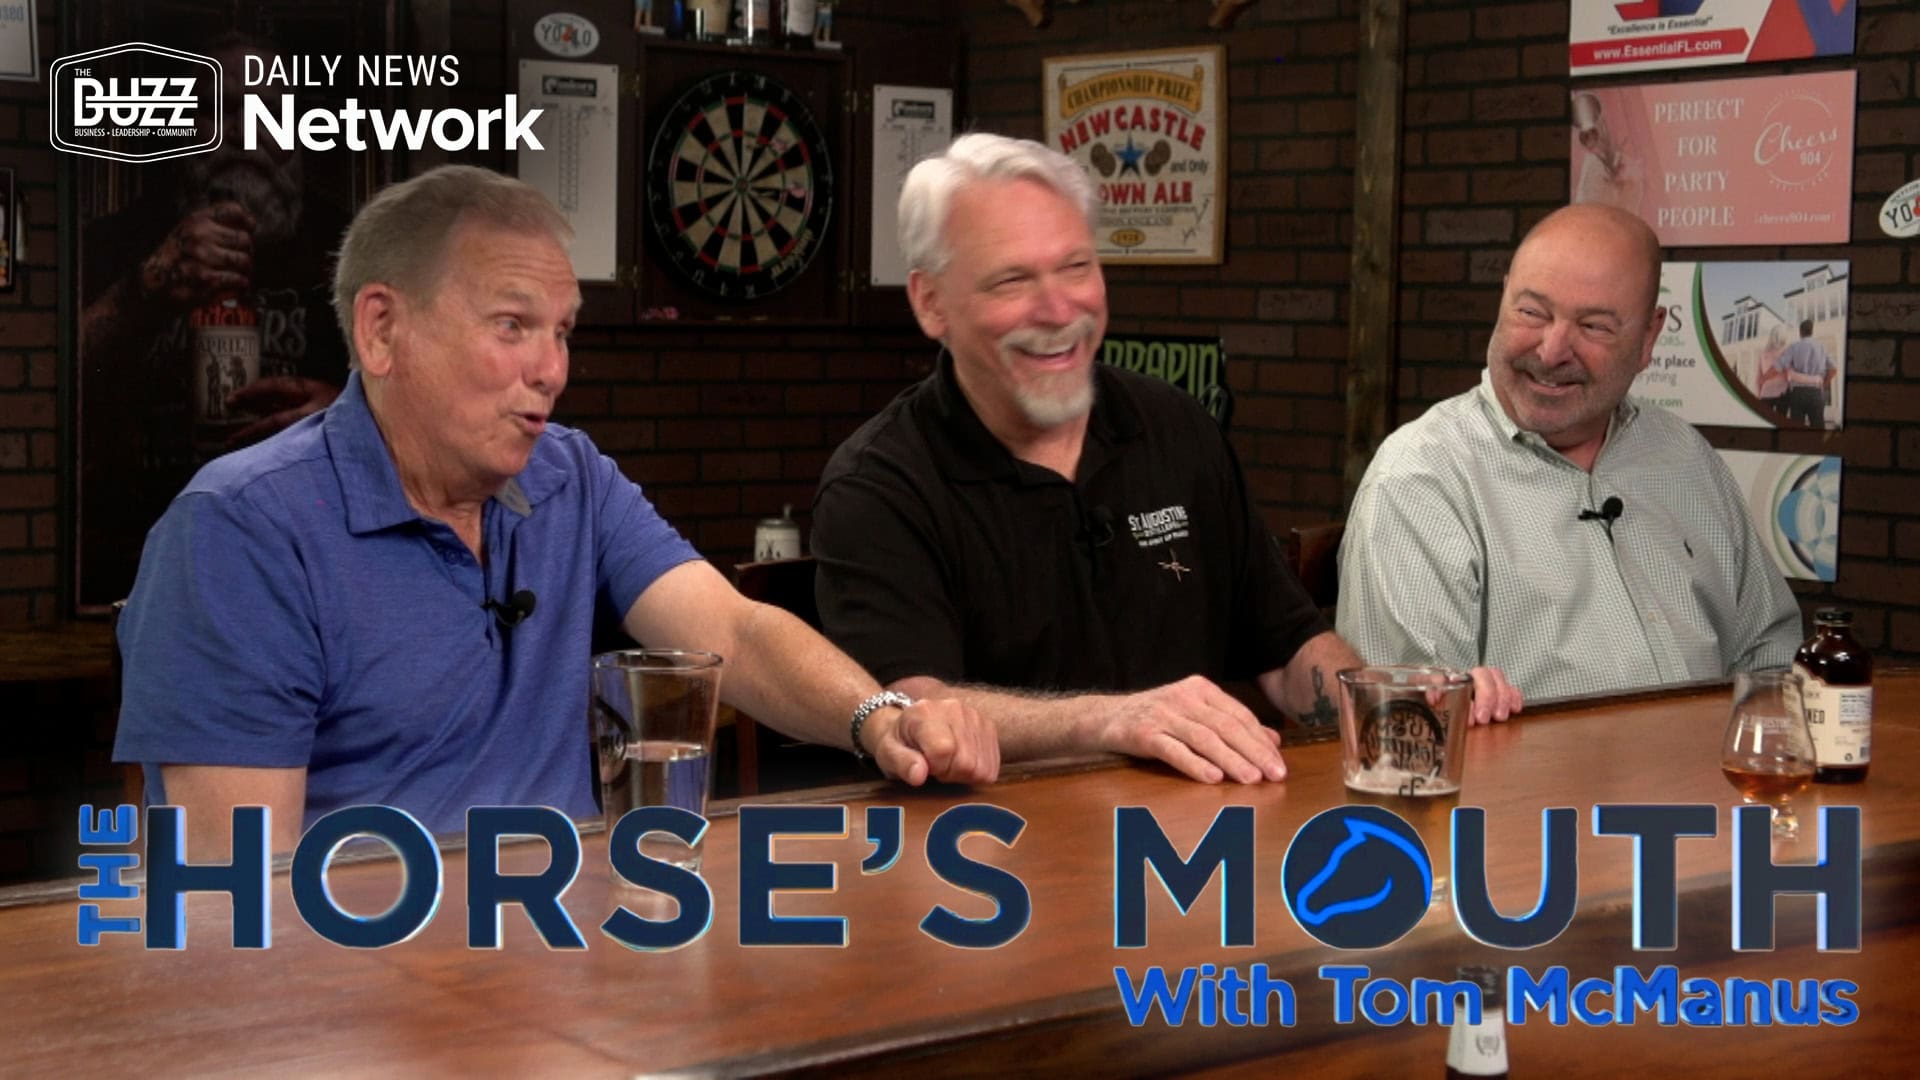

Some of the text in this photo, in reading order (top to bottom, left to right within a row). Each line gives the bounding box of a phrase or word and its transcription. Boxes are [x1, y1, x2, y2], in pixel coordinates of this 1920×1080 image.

[1660, 22, 1666, 30] is
[1668, 16, 1713, 31] Essential"
[1594, 38, 1722, 60] www.EssentialFL.com
[1654, 97, 1745, 124] PERFECT
[1059, 105, 1206, 156] NEWCASTLE
[1677, 135, 1718, 157] FOR
[1754, 121, 1838, 166] Cheers
[1170, 159, 1209, 175] and Only
[1800, 151, 1822, 167] 904
[1664, 170, 1728, 193] PARTY
[1098, 180, 1193, 206] OWN ALE
[1657, 206, 1736, 229] PEOPLE
[1665, 354, 1696, 370] place
